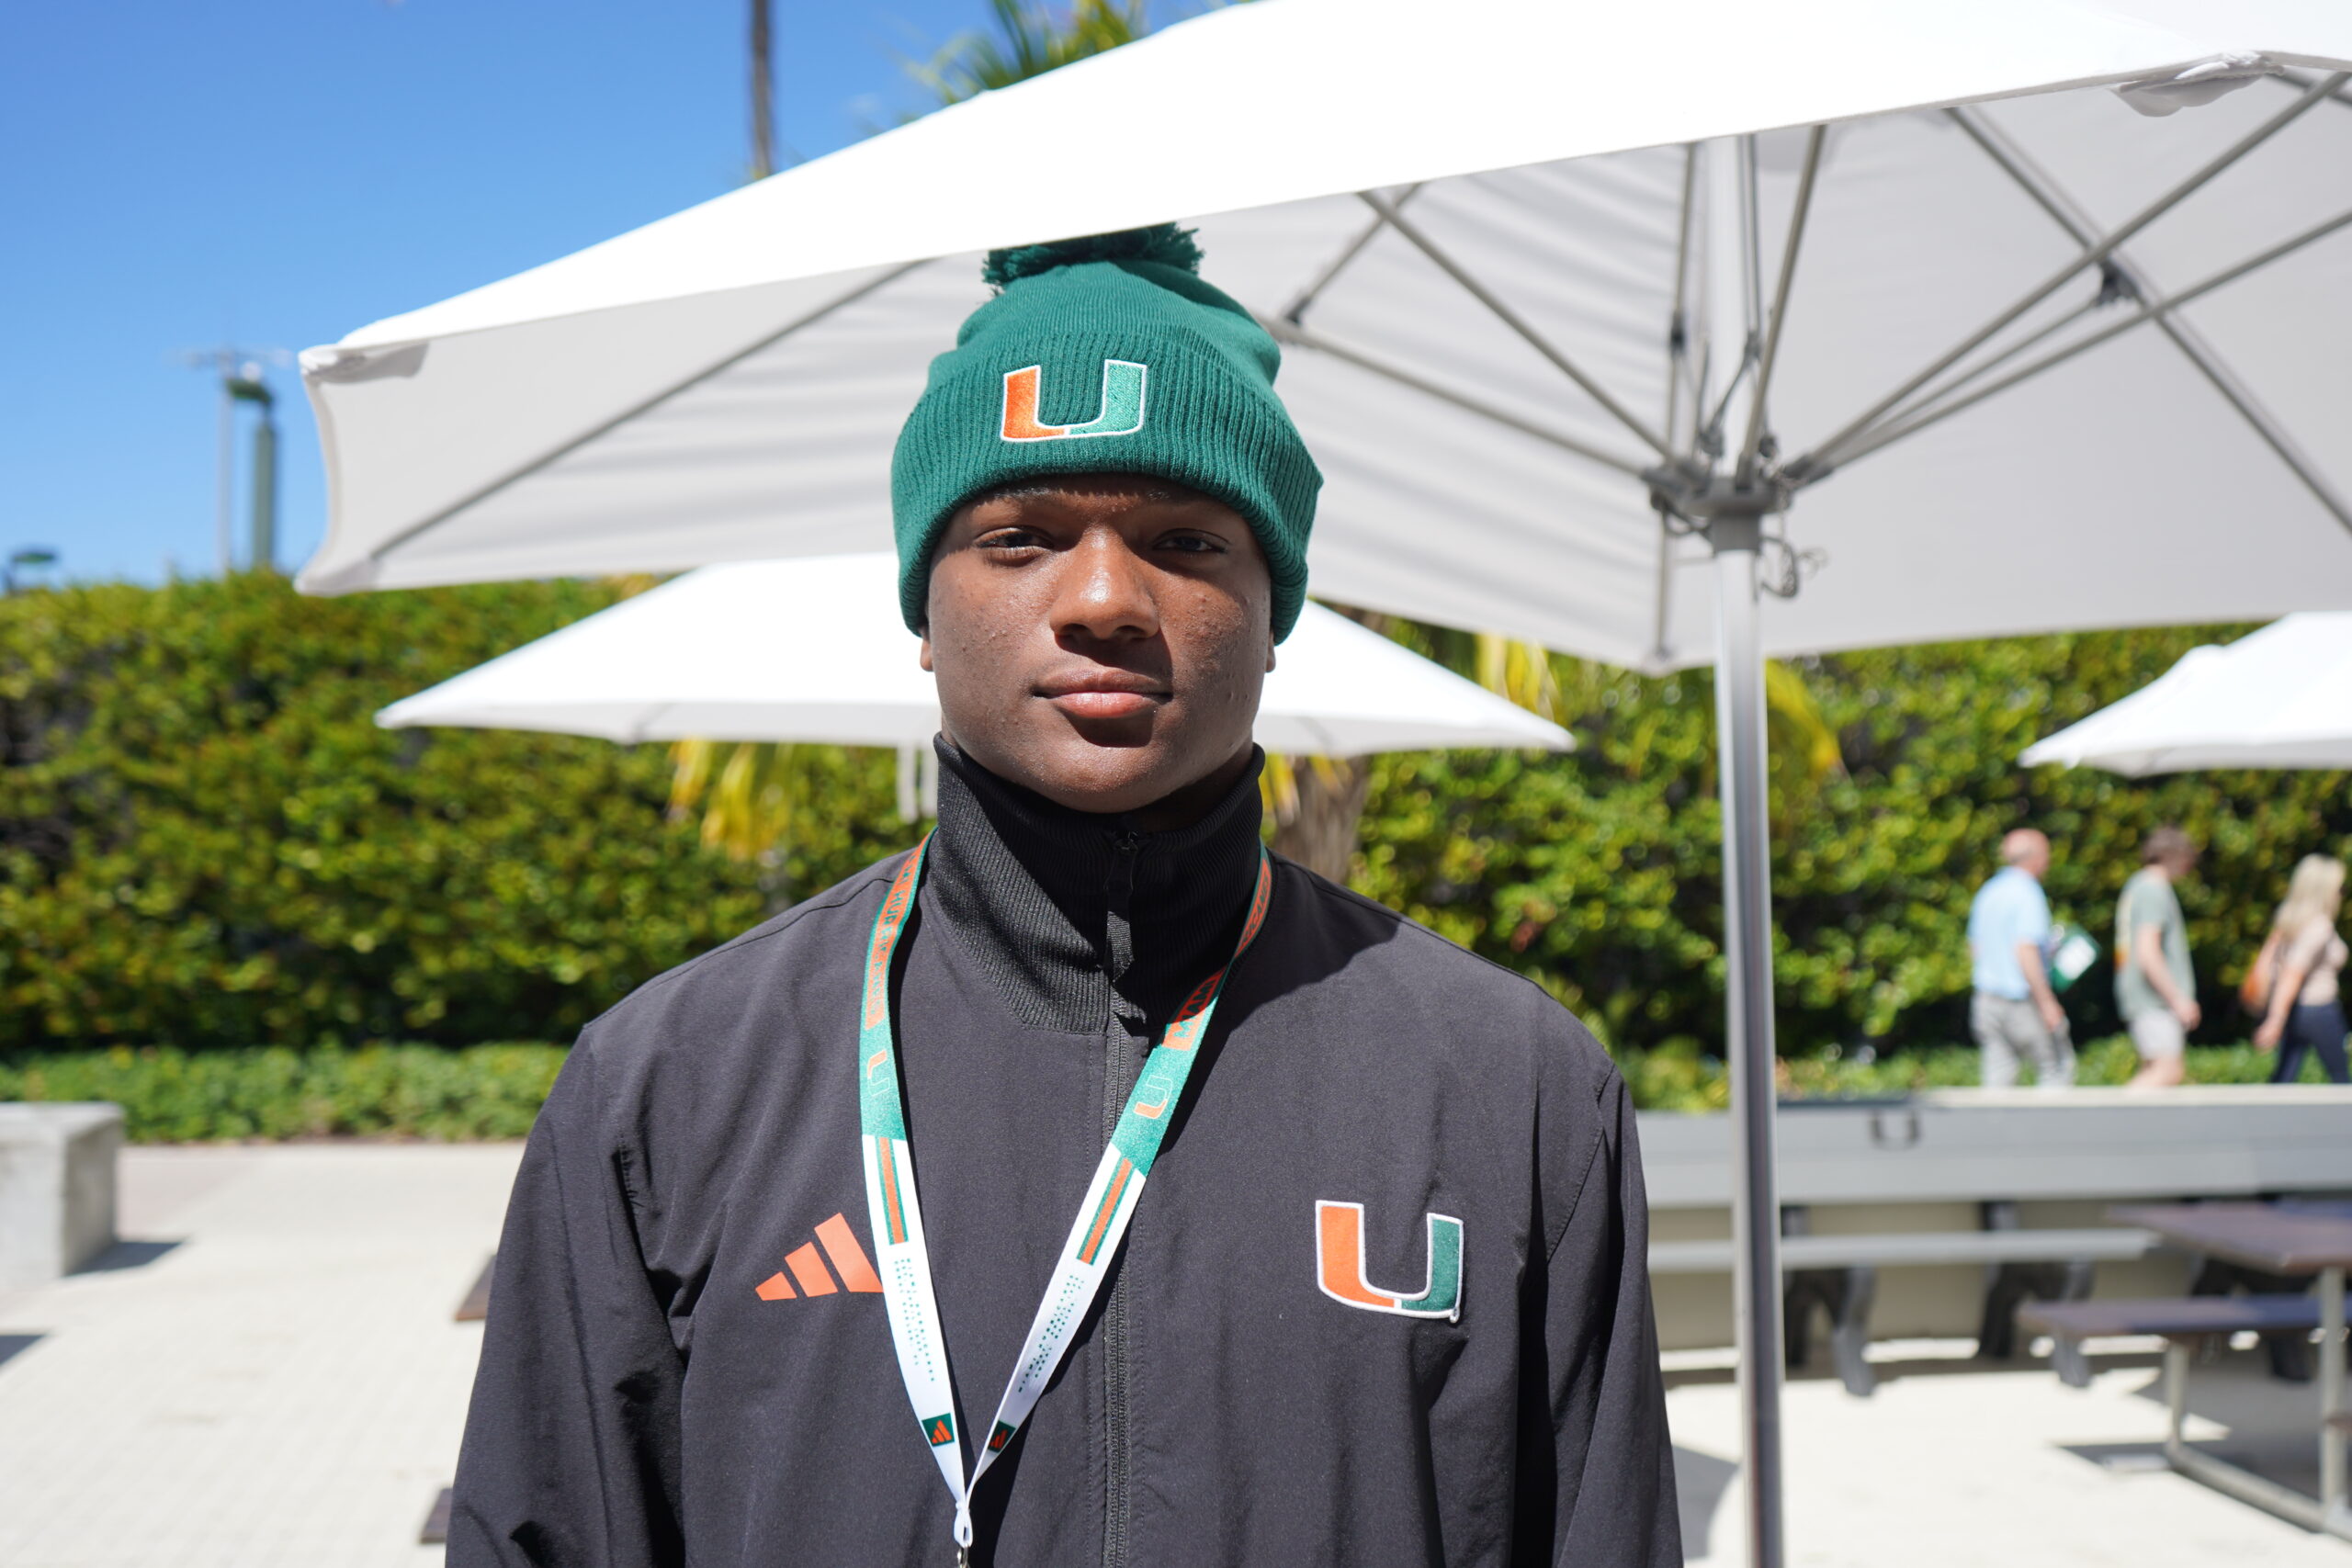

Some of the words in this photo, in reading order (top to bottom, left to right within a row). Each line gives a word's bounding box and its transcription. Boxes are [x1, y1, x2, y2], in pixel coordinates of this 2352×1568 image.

[1000, 359, 1147, 442] U
[1172, 979, 1216, 1039] MIAMI
[866, 1049, 890, 1097] U
[1133, 1075, 1172, 1119] U
[1316, 1200, 1464, 1319] U
